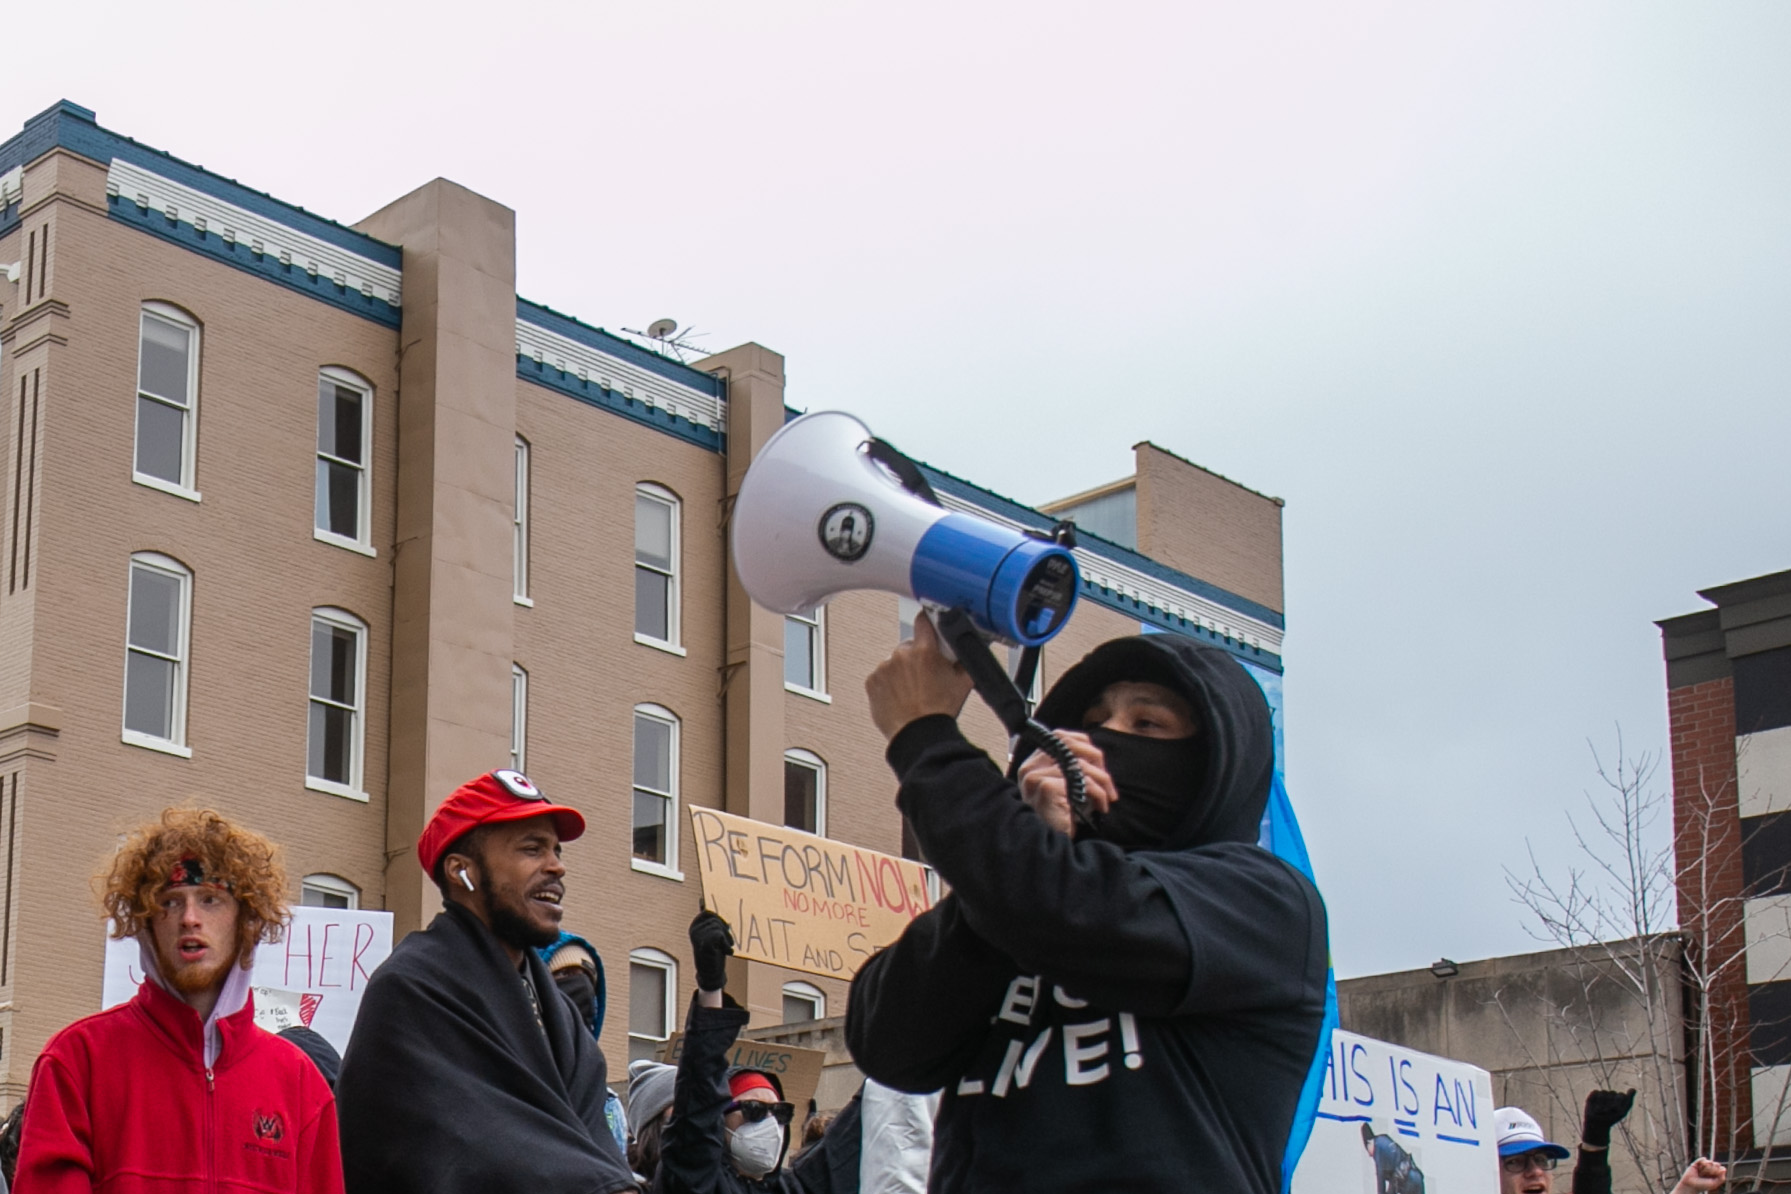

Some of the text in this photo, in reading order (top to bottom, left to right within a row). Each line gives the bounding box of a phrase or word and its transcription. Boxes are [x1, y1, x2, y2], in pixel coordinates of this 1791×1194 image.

[693, 810, 932, 921] REFORM NOW
[710, 894, 796, 962] WAIT
[802, 943, 844, 973] AND
[783, 887, 871, 928] NO MORE
[732, 1047, 793, 1074] LIVES
[1321, 1041, 1478, 1130] HIS IS AN
